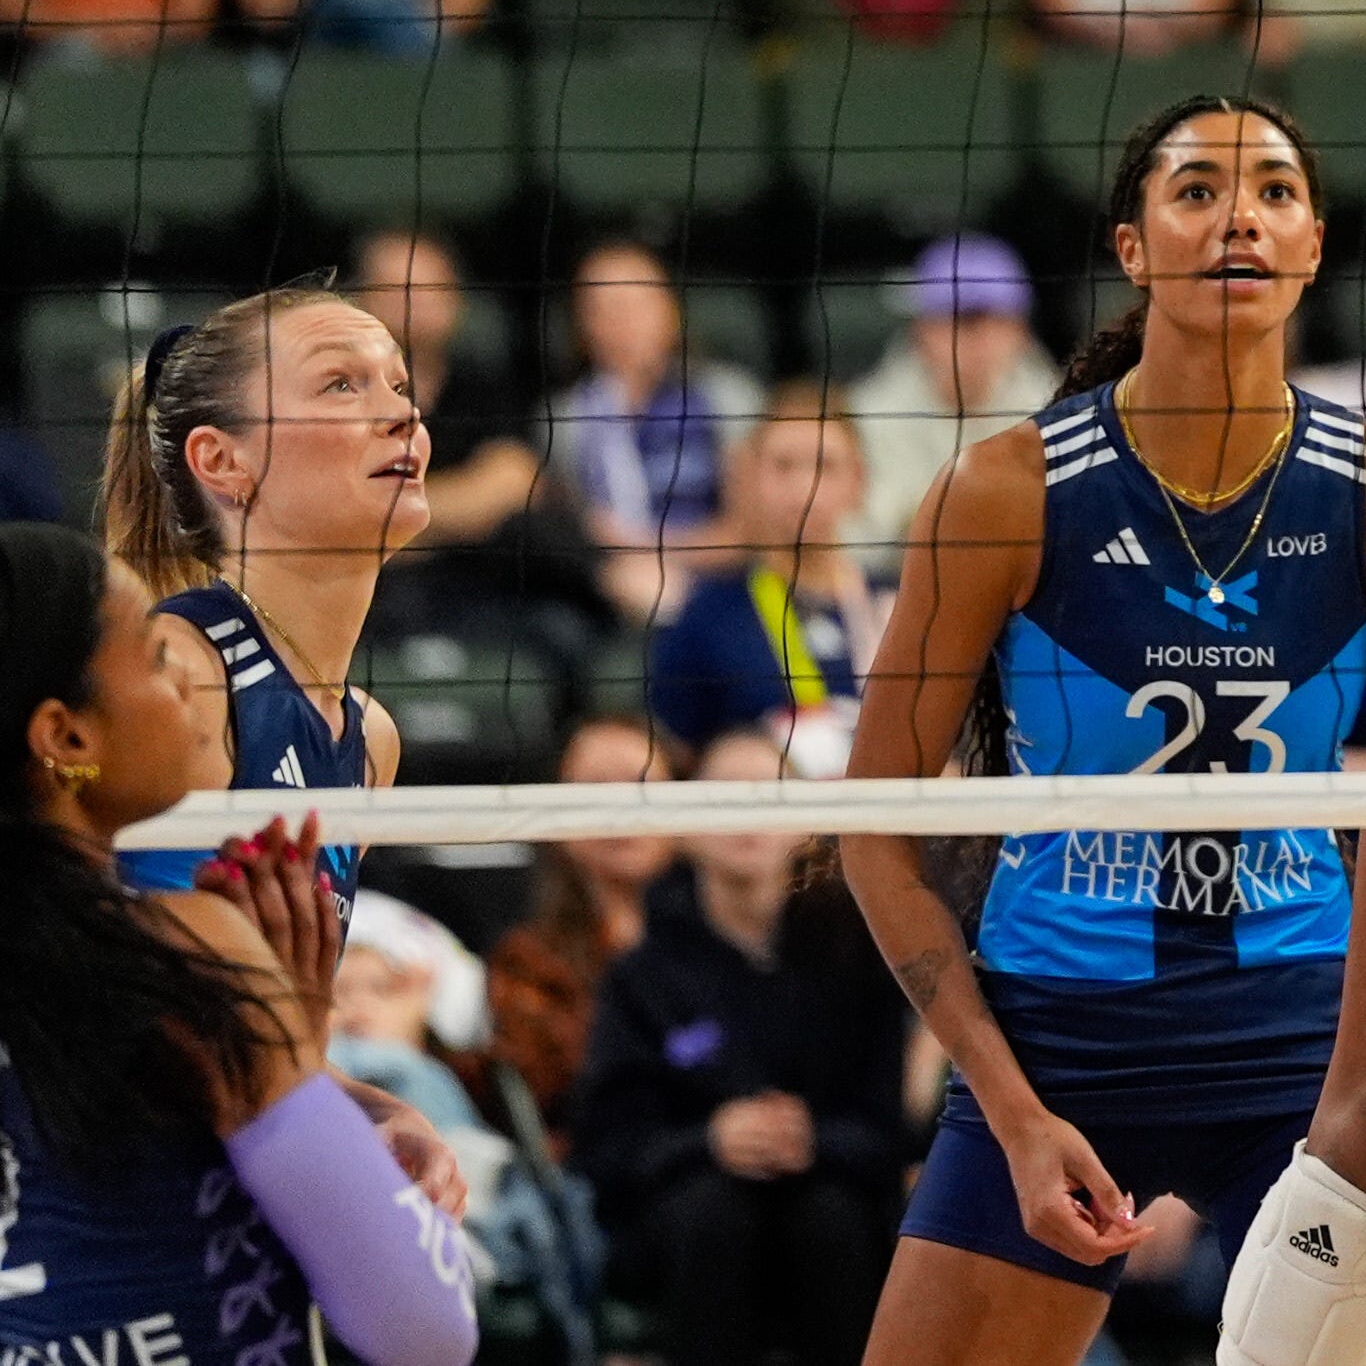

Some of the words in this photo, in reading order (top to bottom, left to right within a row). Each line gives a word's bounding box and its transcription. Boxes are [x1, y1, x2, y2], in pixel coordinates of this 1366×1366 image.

[1267, 532, 1327, 557] LOVB
[1145, 646, 1275, 668] HOUSTON
[1125, 680, 1291, 774] 23
[1064, 829, 1313, 883] MEMORIAL
[1060, 857, 1312, 916] HERMANN
[1289, 1236, 1339, 1267] adidas
